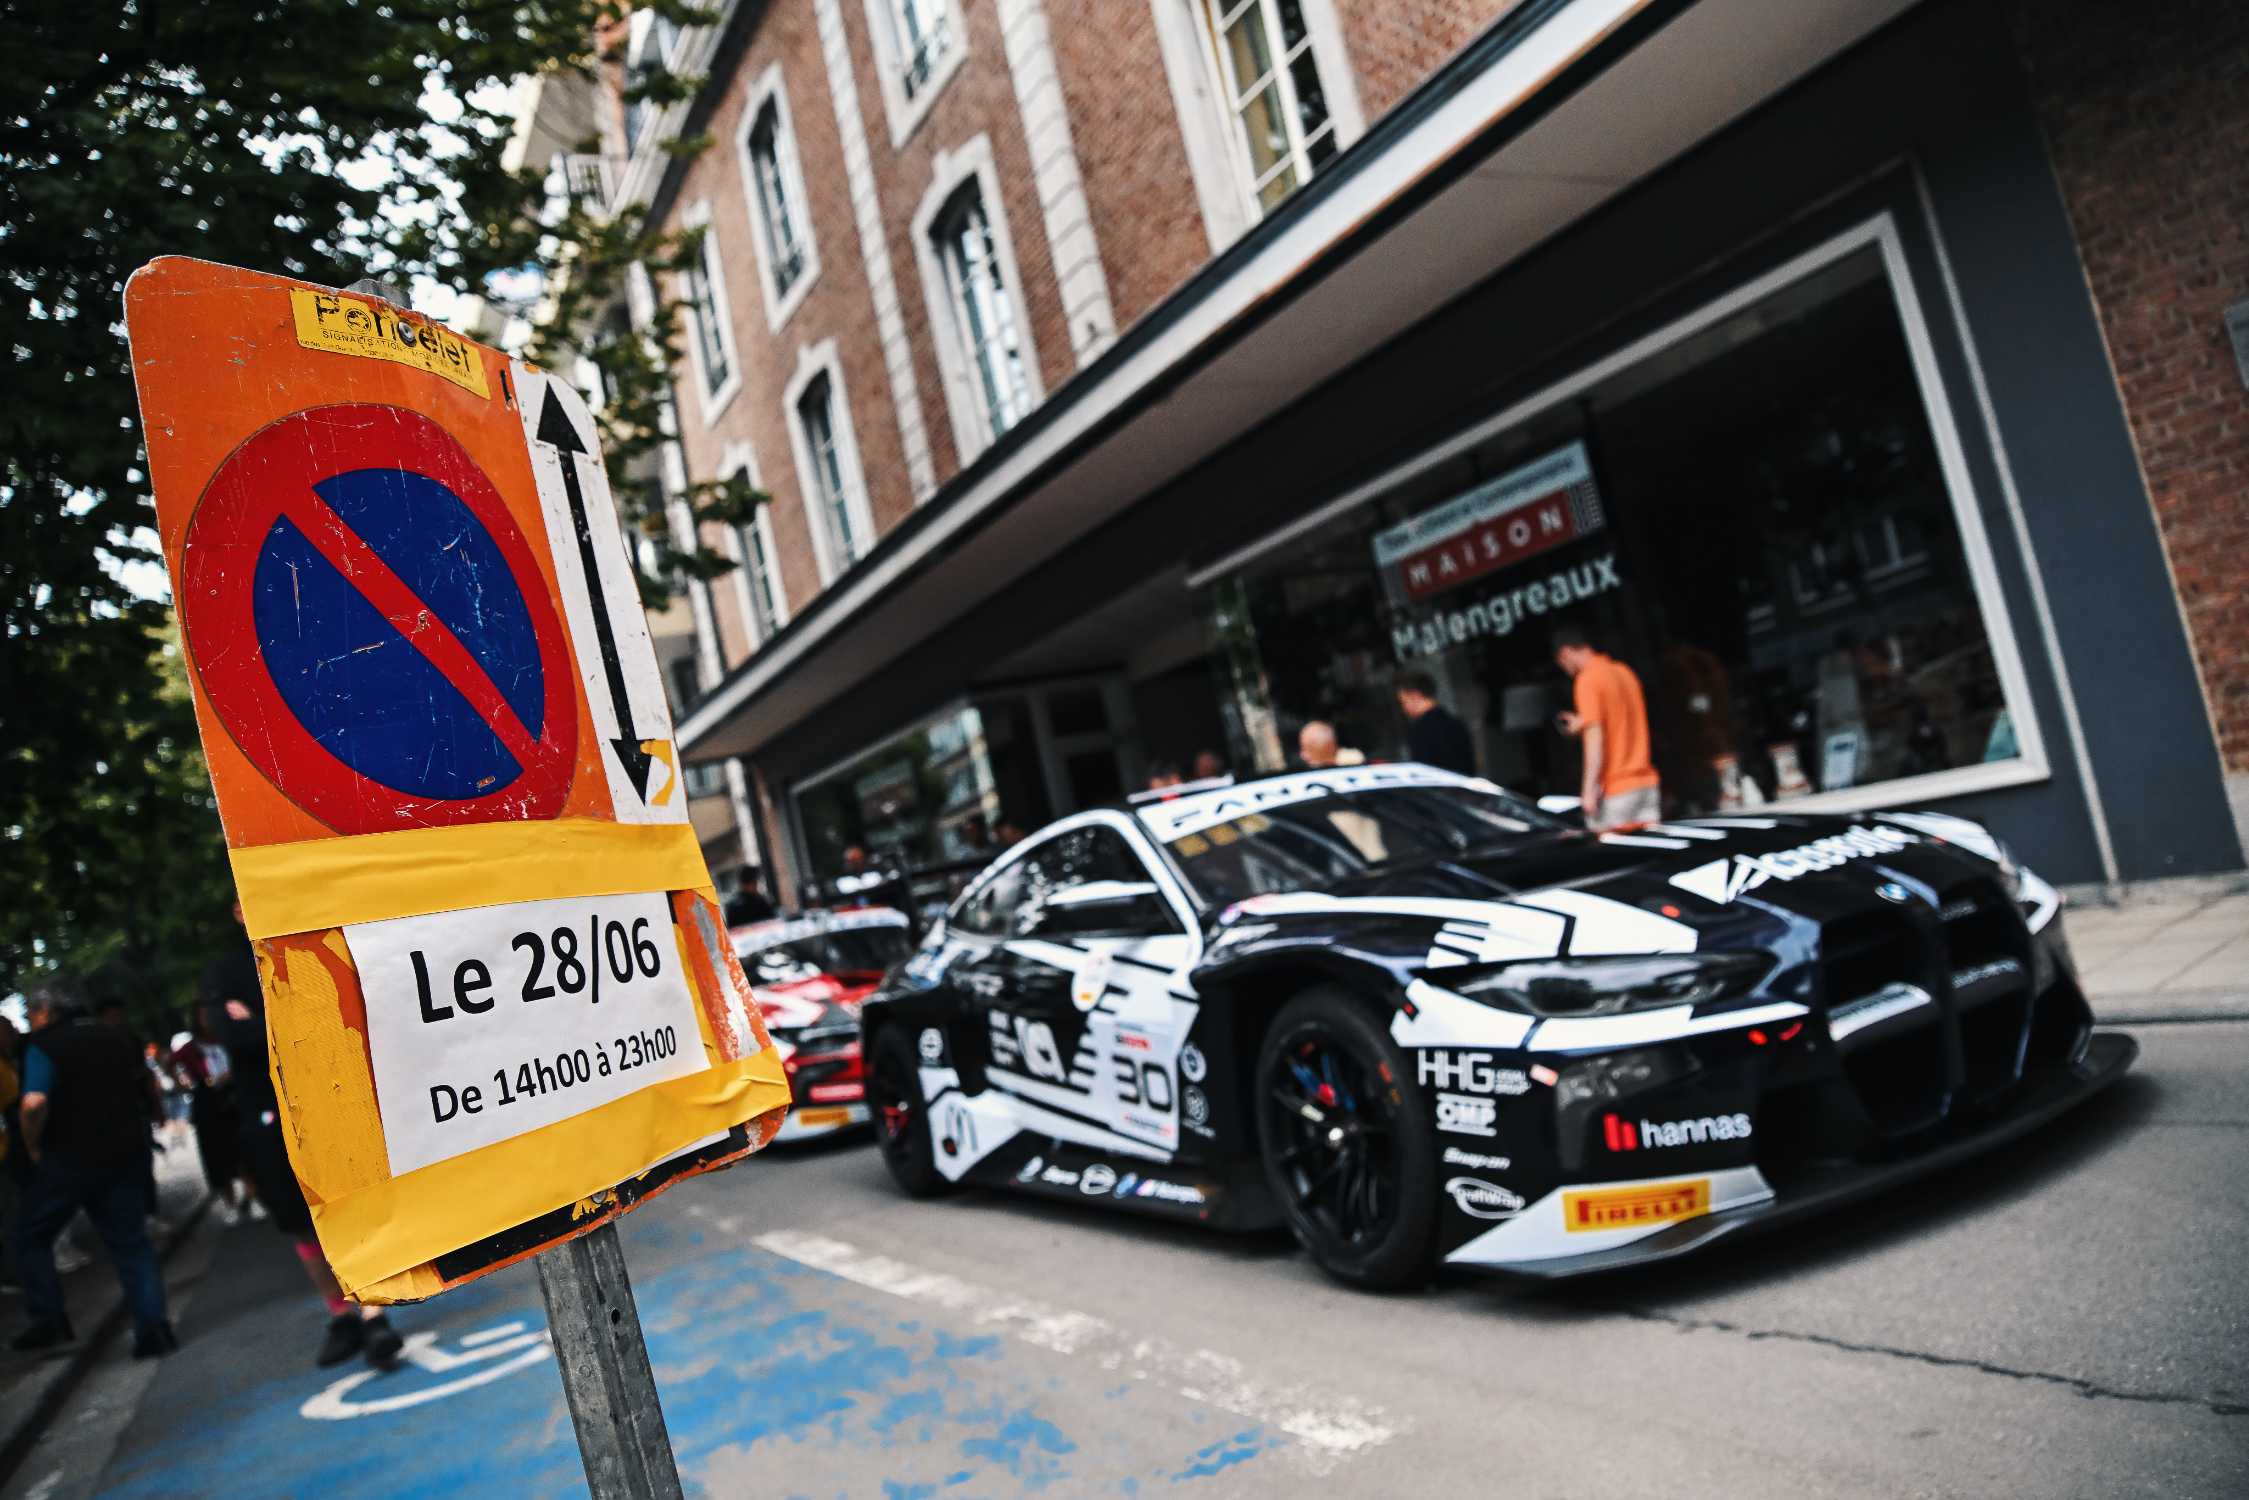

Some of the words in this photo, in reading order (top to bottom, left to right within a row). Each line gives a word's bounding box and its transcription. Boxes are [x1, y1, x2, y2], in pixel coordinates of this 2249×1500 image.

[1409, 506, 1564, 588] MAISON
[1393, 552, 1621, 662] Malengreaux
[410, 950, 495, 1024] Le
[511, 914, 661, 1004] 28/06
[430, 1084, 483, 1124] De
[493, 1048, 591, 1106] 14h00
[596, 1042, 612, 1077] à
[614, 1025, 676, 1071] 23h00
[1112, 1053, 1173, 1114] 30
[1418, 1049, 1495, 1093] HHG
[1641, 1112, 1753, 1150] hannas
[1577, 1188, 1698, 1226] PIRELLI
